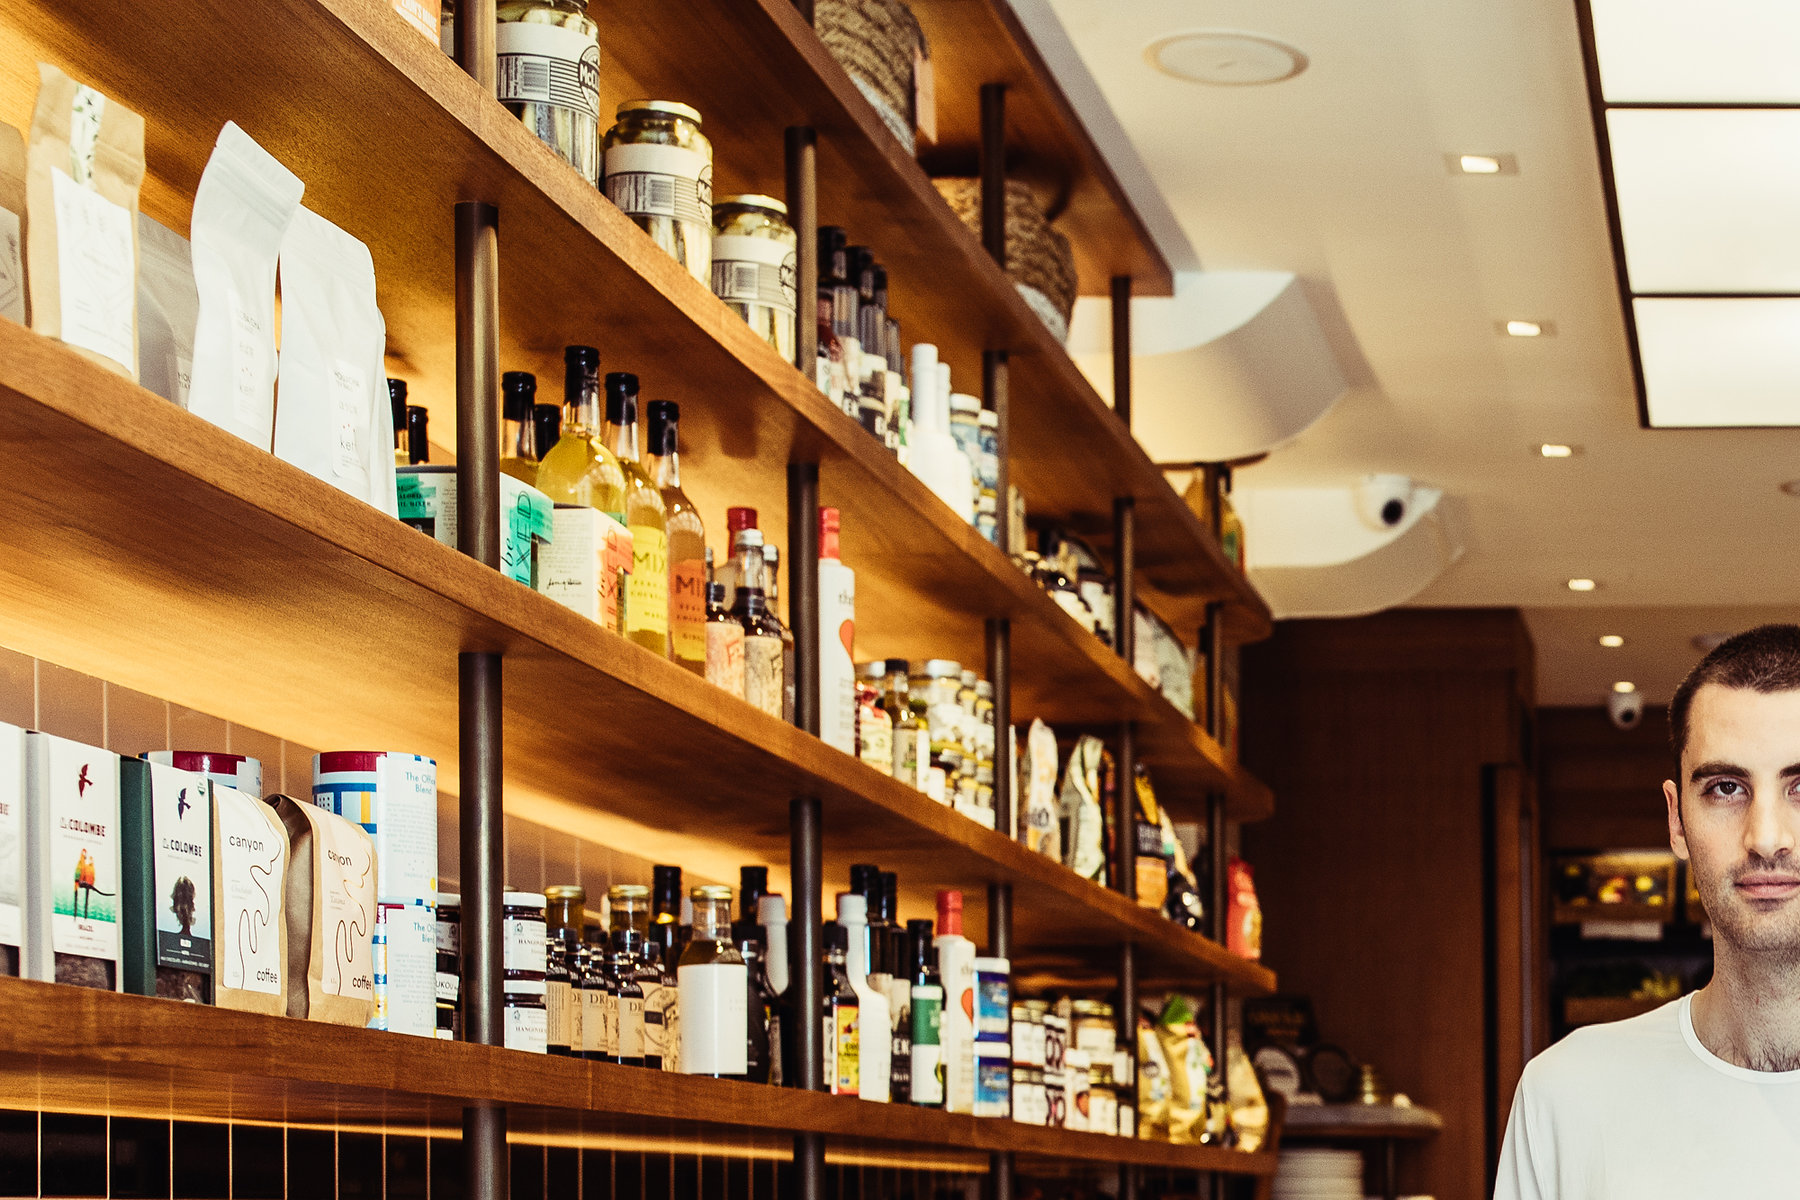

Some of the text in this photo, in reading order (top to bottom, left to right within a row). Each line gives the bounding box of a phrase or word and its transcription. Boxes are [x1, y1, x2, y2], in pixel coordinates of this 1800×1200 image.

[515, 490, 532, 586] IXED
[406, 771, 419, 782] The
[415, 785, 432, 795] Blend
[69, 818, 106, 838] COLOMBE
[170, 839, 203, 858] COLOMBE
[229, 834, 264, 853] canyon
[327, 849, 352, 867] canyon
[256, 968, 278, 984] coffee
[352, 975, 372, 991] coffee
